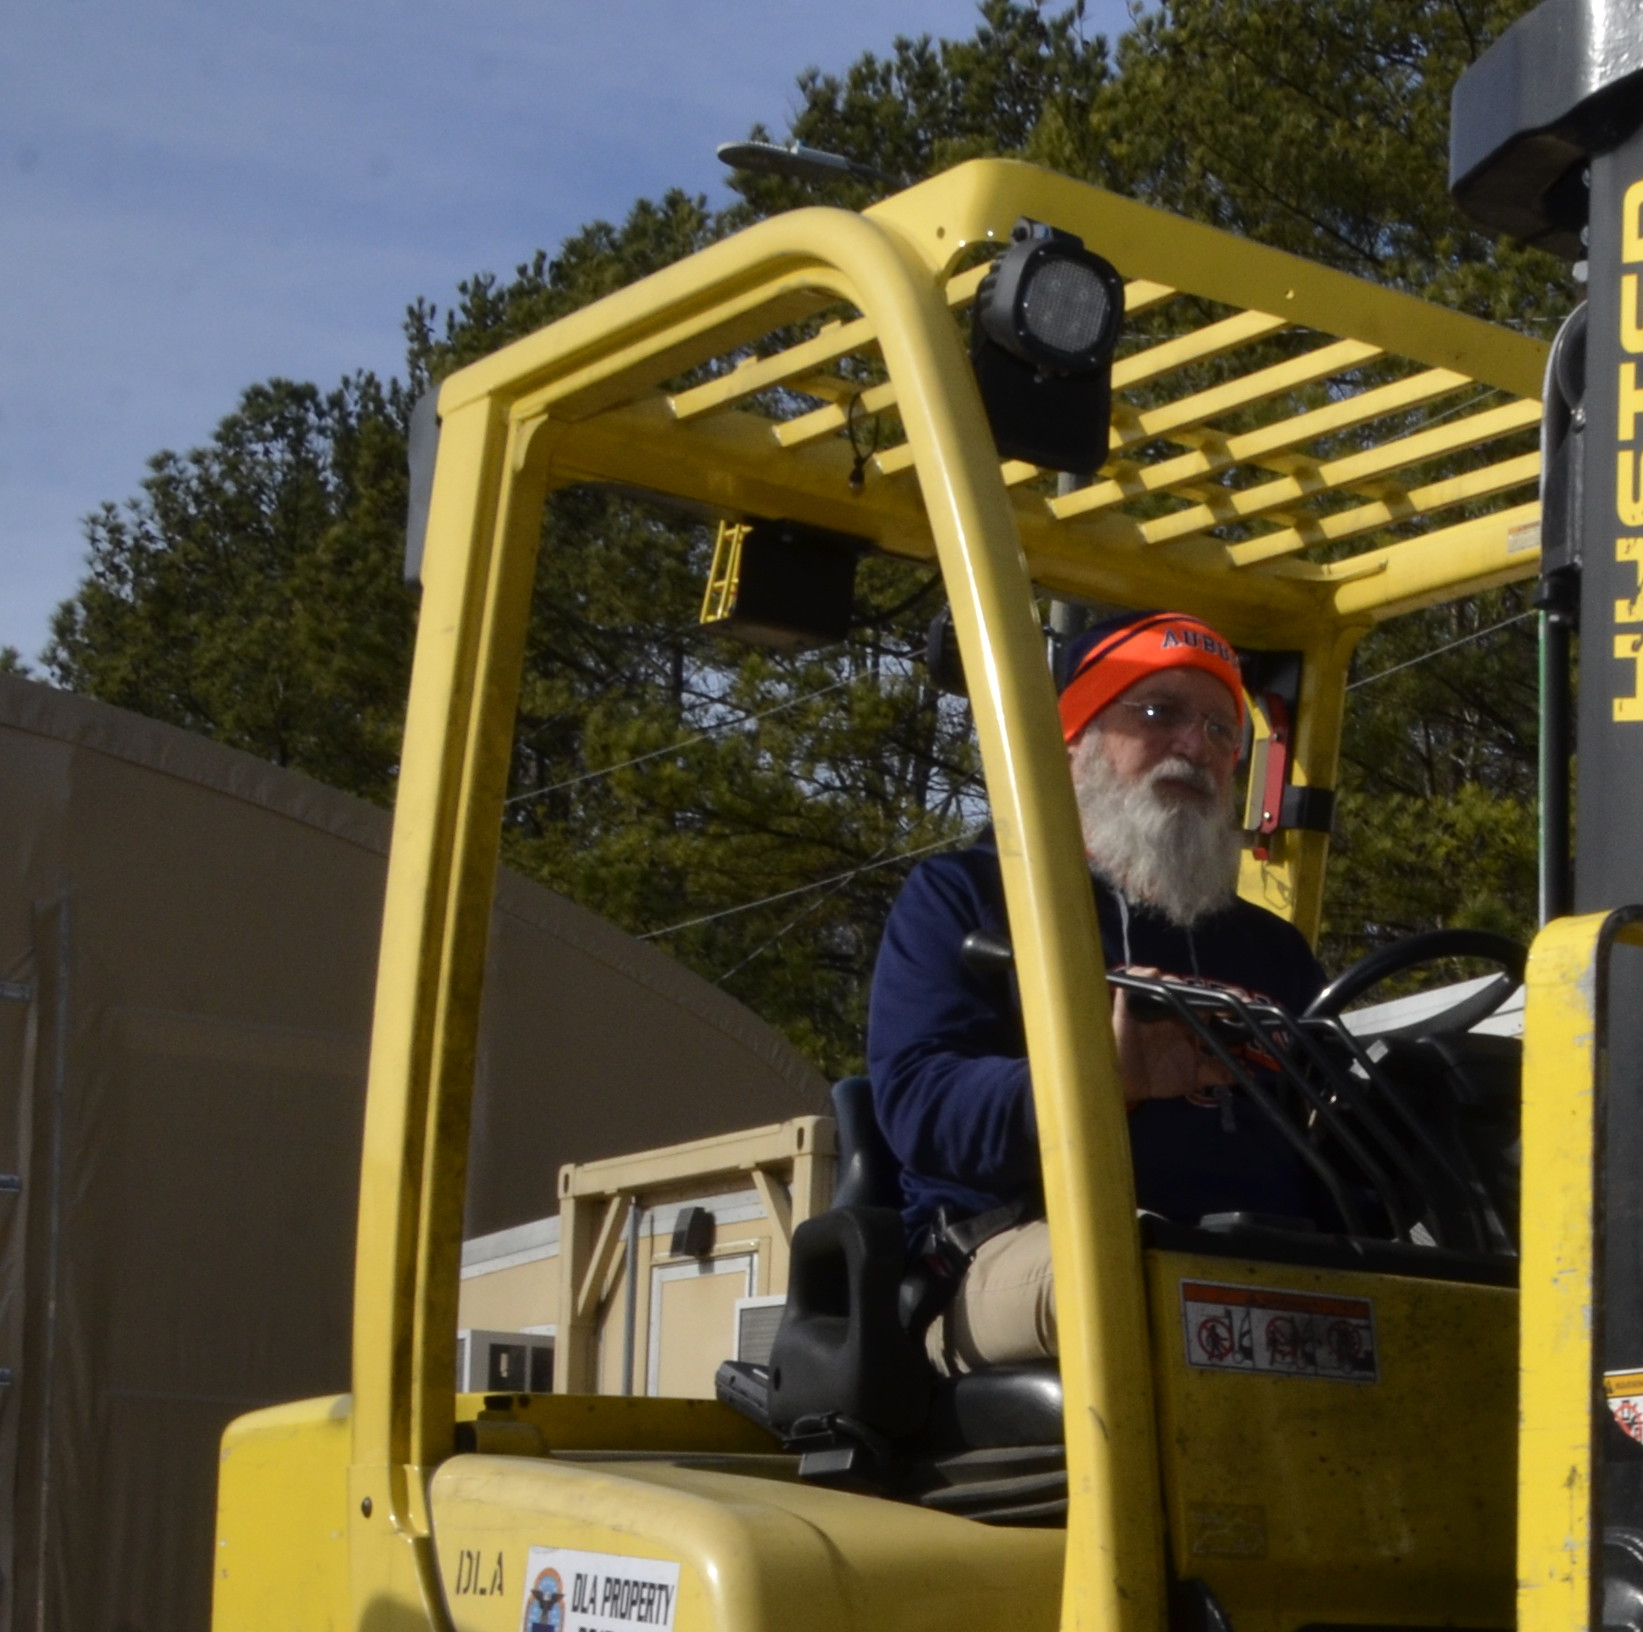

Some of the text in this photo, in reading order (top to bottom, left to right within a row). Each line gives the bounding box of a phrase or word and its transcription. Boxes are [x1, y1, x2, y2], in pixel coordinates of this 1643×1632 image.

[455, 1549, 504, 1597] DLA
[571, 1572, 674, 1625] DLA PROPERTY
